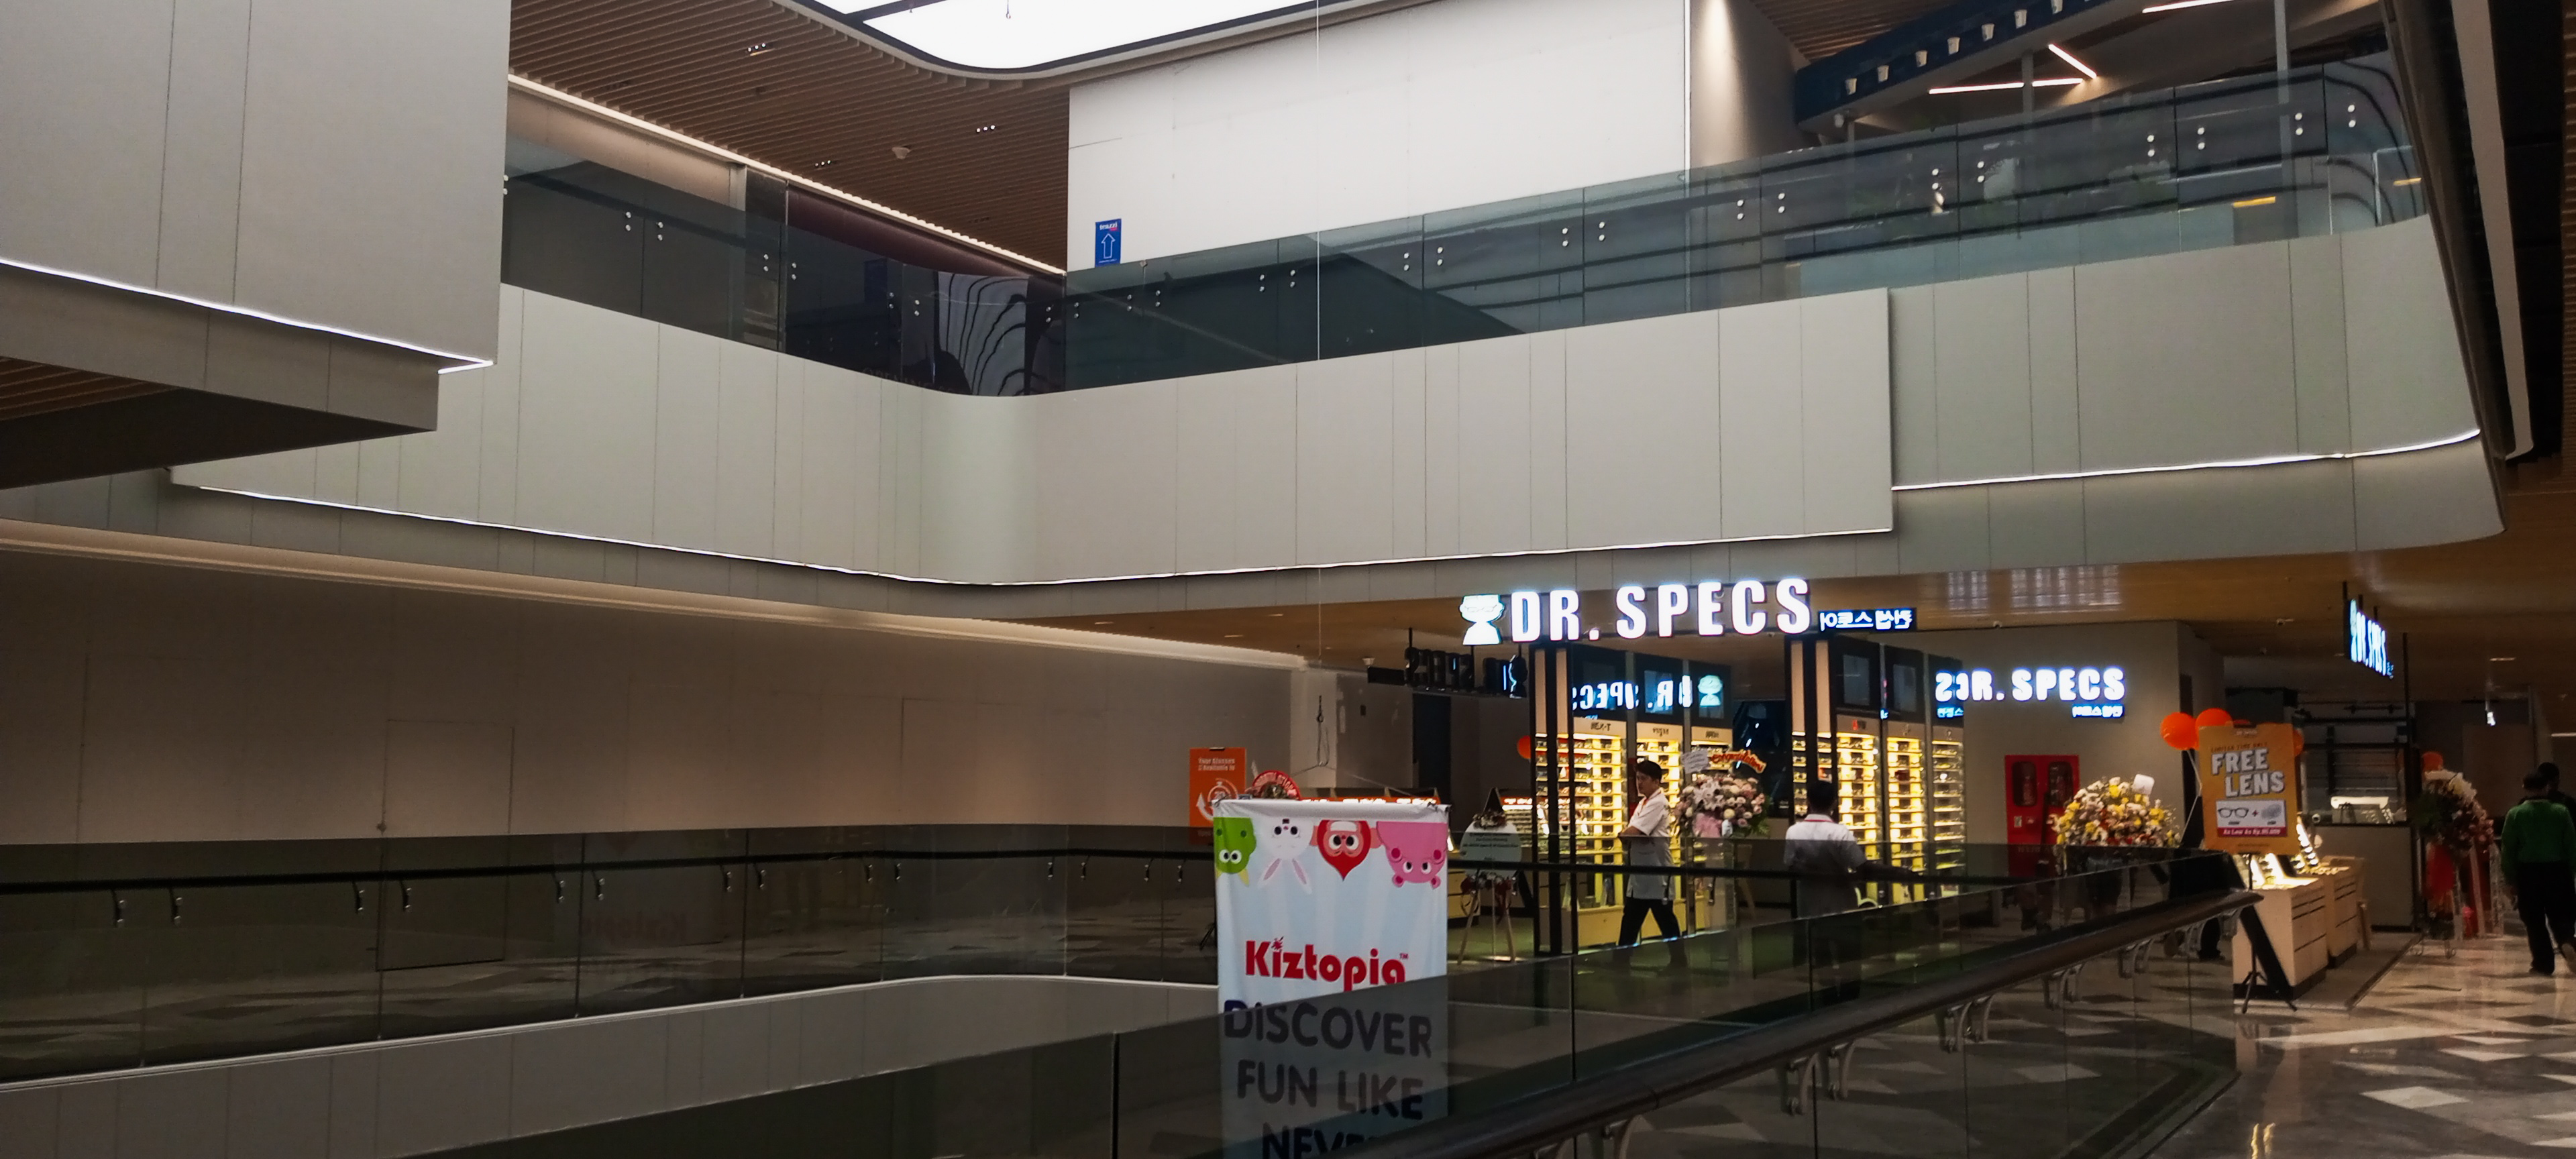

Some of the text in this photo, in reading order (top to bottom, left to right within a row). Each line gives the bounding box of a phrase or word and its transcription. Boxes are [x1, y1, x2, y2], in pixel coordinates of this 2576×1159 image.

[1511, 578, 1811, 643] DR. SPECS
[2011, 667, 2126, 702] SPECS
[2212, 749, 2269, 775] FREE
[2224, 771, 2285, 798] LENS
[1246, 936, 1406, 992] Kiztopia
[1224, 999, 1432, 1058] DISCOVER
[1236, 1059, 1424, 1120] FUN LIKE
